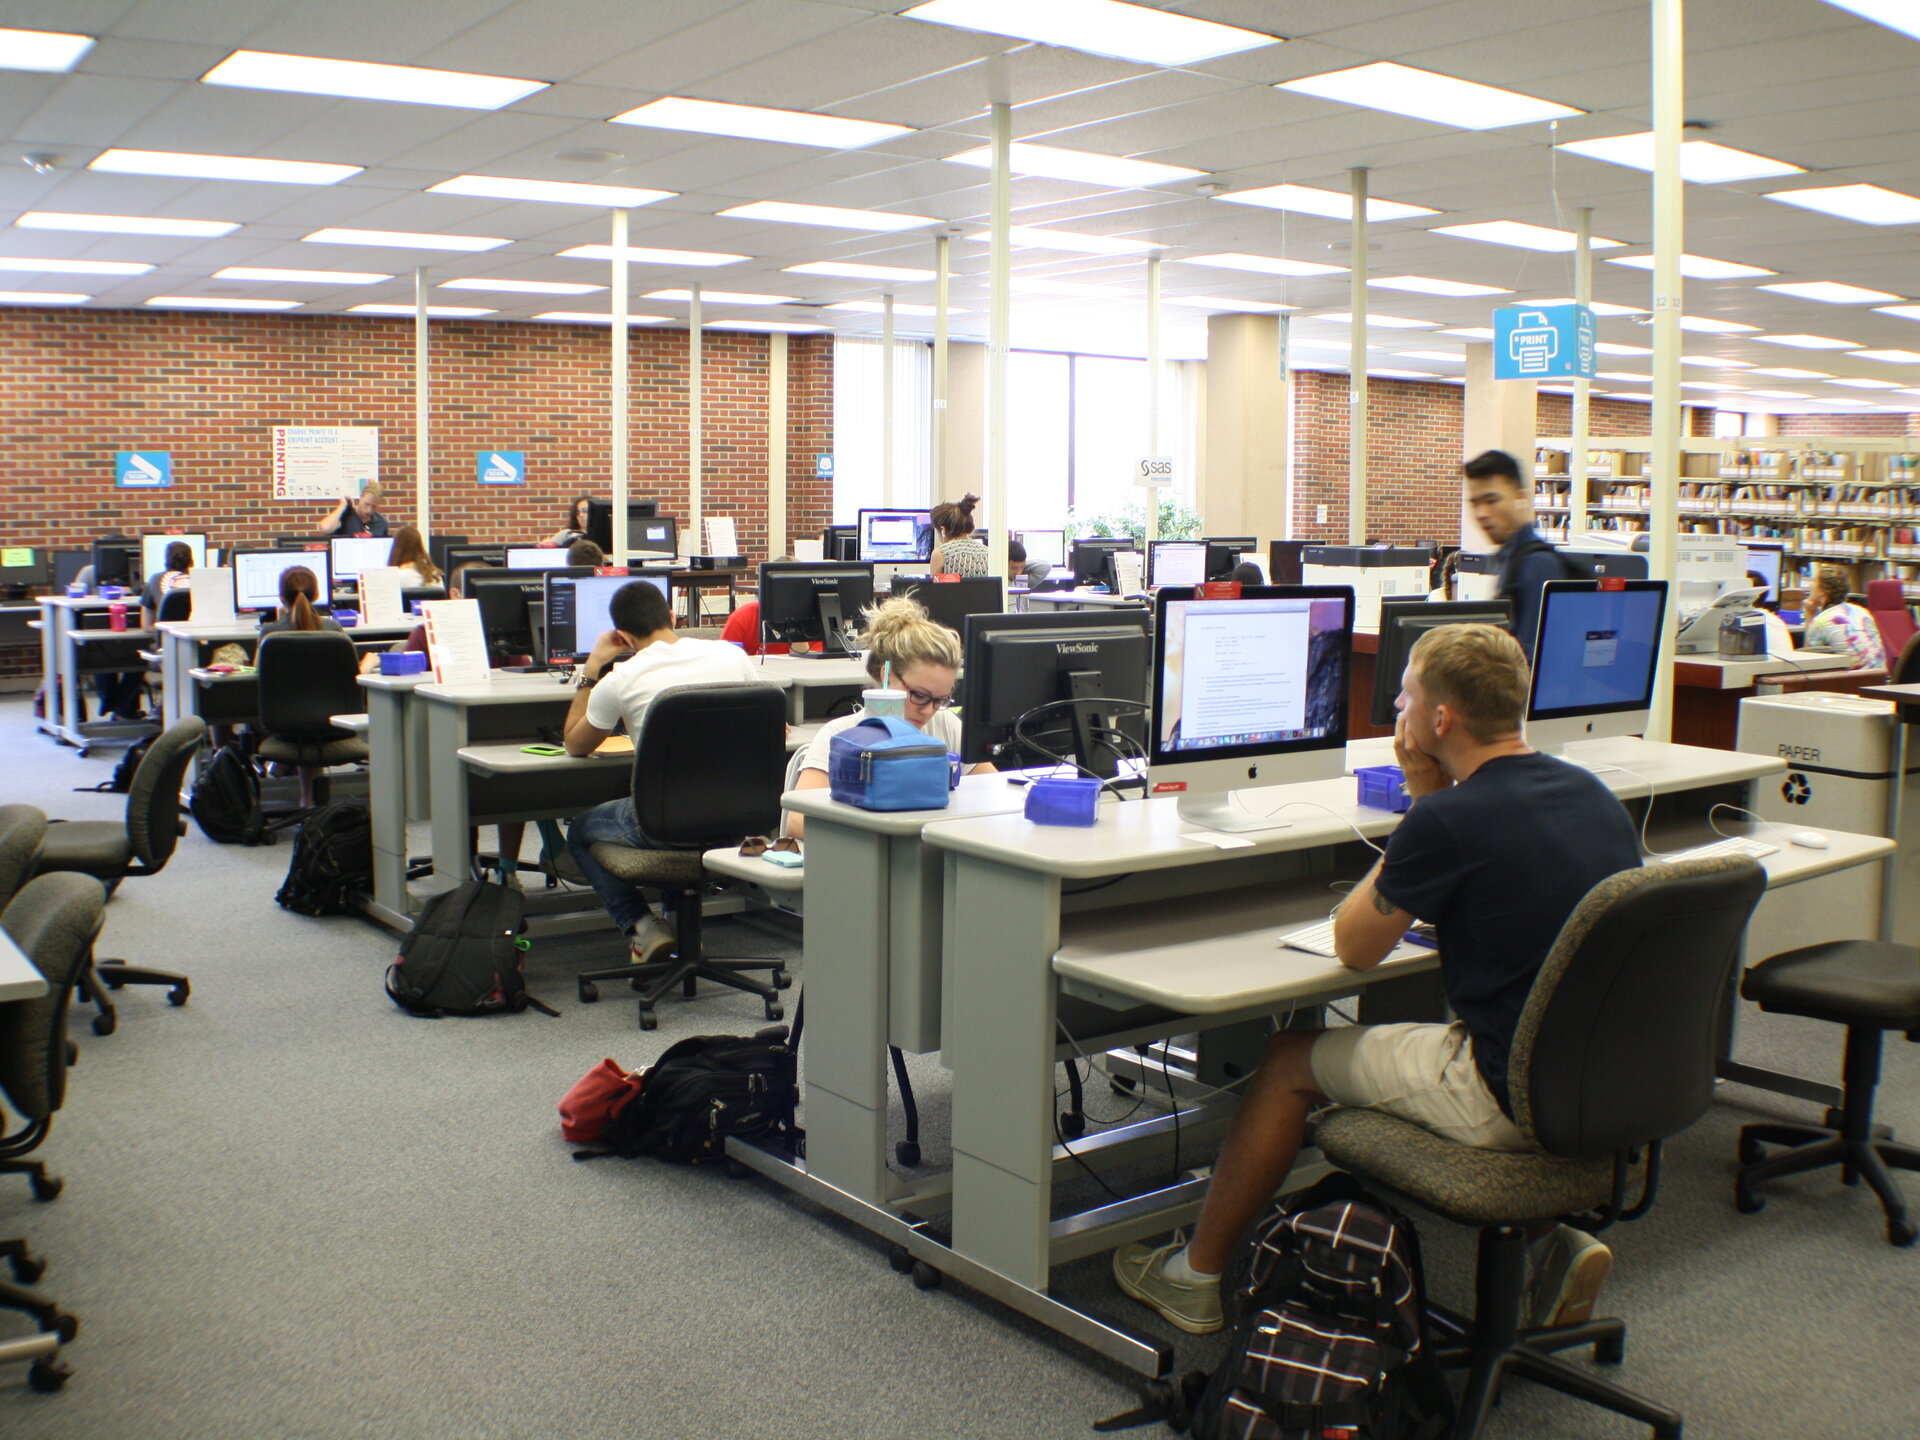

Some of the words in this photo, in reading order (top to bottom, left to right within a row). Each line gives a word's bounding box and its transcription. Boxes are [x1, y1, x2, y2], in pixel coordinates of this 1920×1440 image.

[1656, 296, 1667, 306] 12
[1520, 334, 1549, 346] PRINT
[276, 429, 286, 497] PRINTING
[1150, 462, 1172, 474] sas
[1196, 586, 1205, 597] N
[1055, 642, 1099, 654] ViewSonic
[1777, 743, 1821, 762] PAPER
